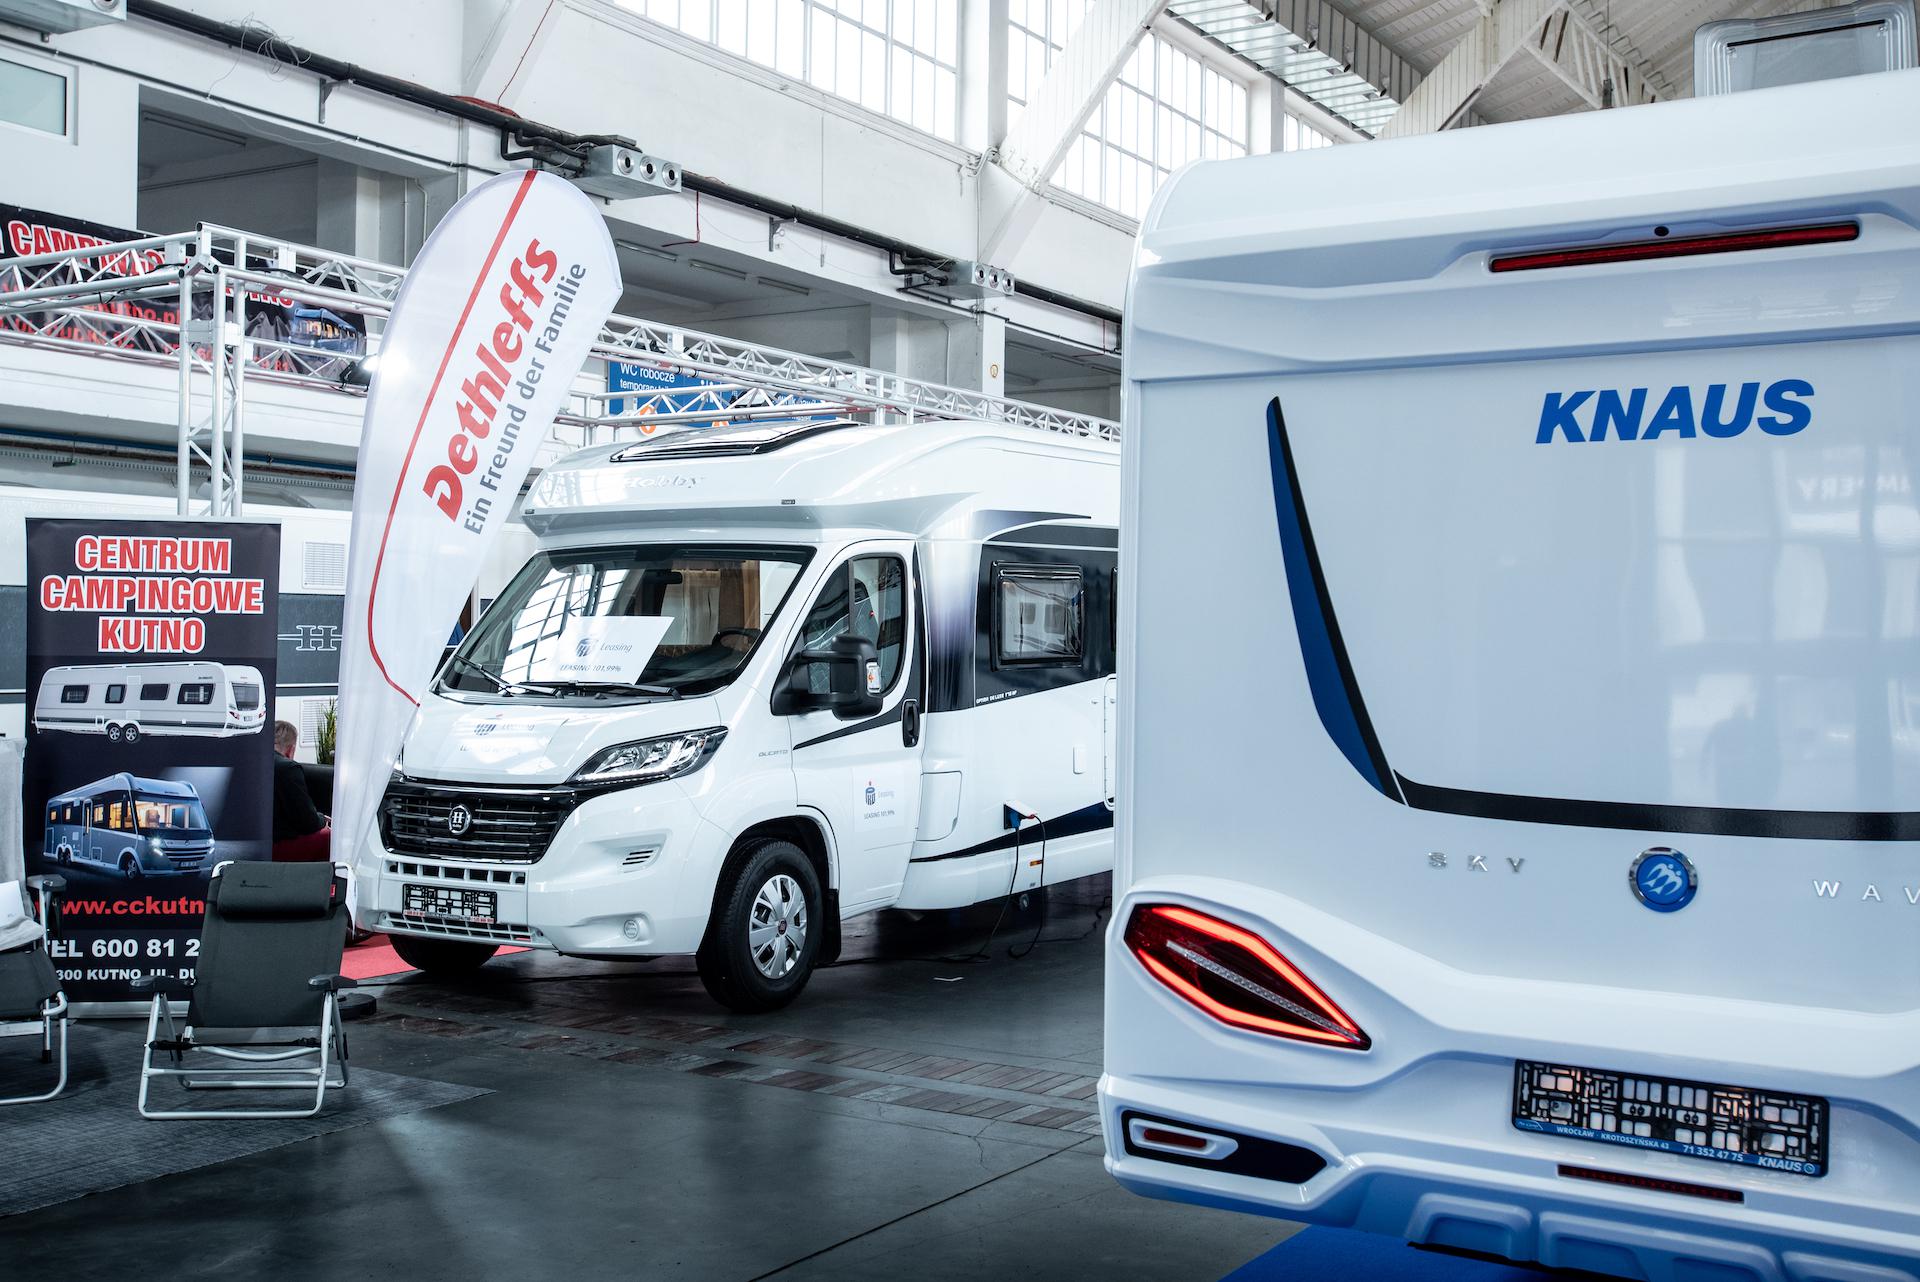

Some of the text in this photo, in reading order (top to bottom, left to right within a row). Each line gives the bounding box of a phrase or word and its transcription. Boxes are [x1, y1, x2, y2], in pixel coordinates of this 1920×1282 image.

[423, 238, 557, 522] Dethleffs
[620, 362, 675, 384] WC robocze
[464, 263, 586, 535] Ein Freund der Familie
[1535, 379, 1815, 444] KNAUS
[75, 535, 232, 574] CENTRUM
[41, 575, 264, 614] CAMPINGOWE
[98, 616, 206, 653] KUTNO
[1428, 852, 1524, 875] SKY
[47, 939, 83, 957] EL
[92, 938, 138, 957] 600
[146, 938, 175, 957] 81
[87, 968, 142, 980] KUTNO
[1556, 1125, 1595, 1138] WROCŁAW
[1683, 1144, 1694, 1154] 71
[1696, 1147, 1715, 1158] 352
[1717, 1150, 1729, 1160] 47
[1731, 1152, 1744, 1163] 75
[1757, 1155, 1802, 1173] KNAUS
